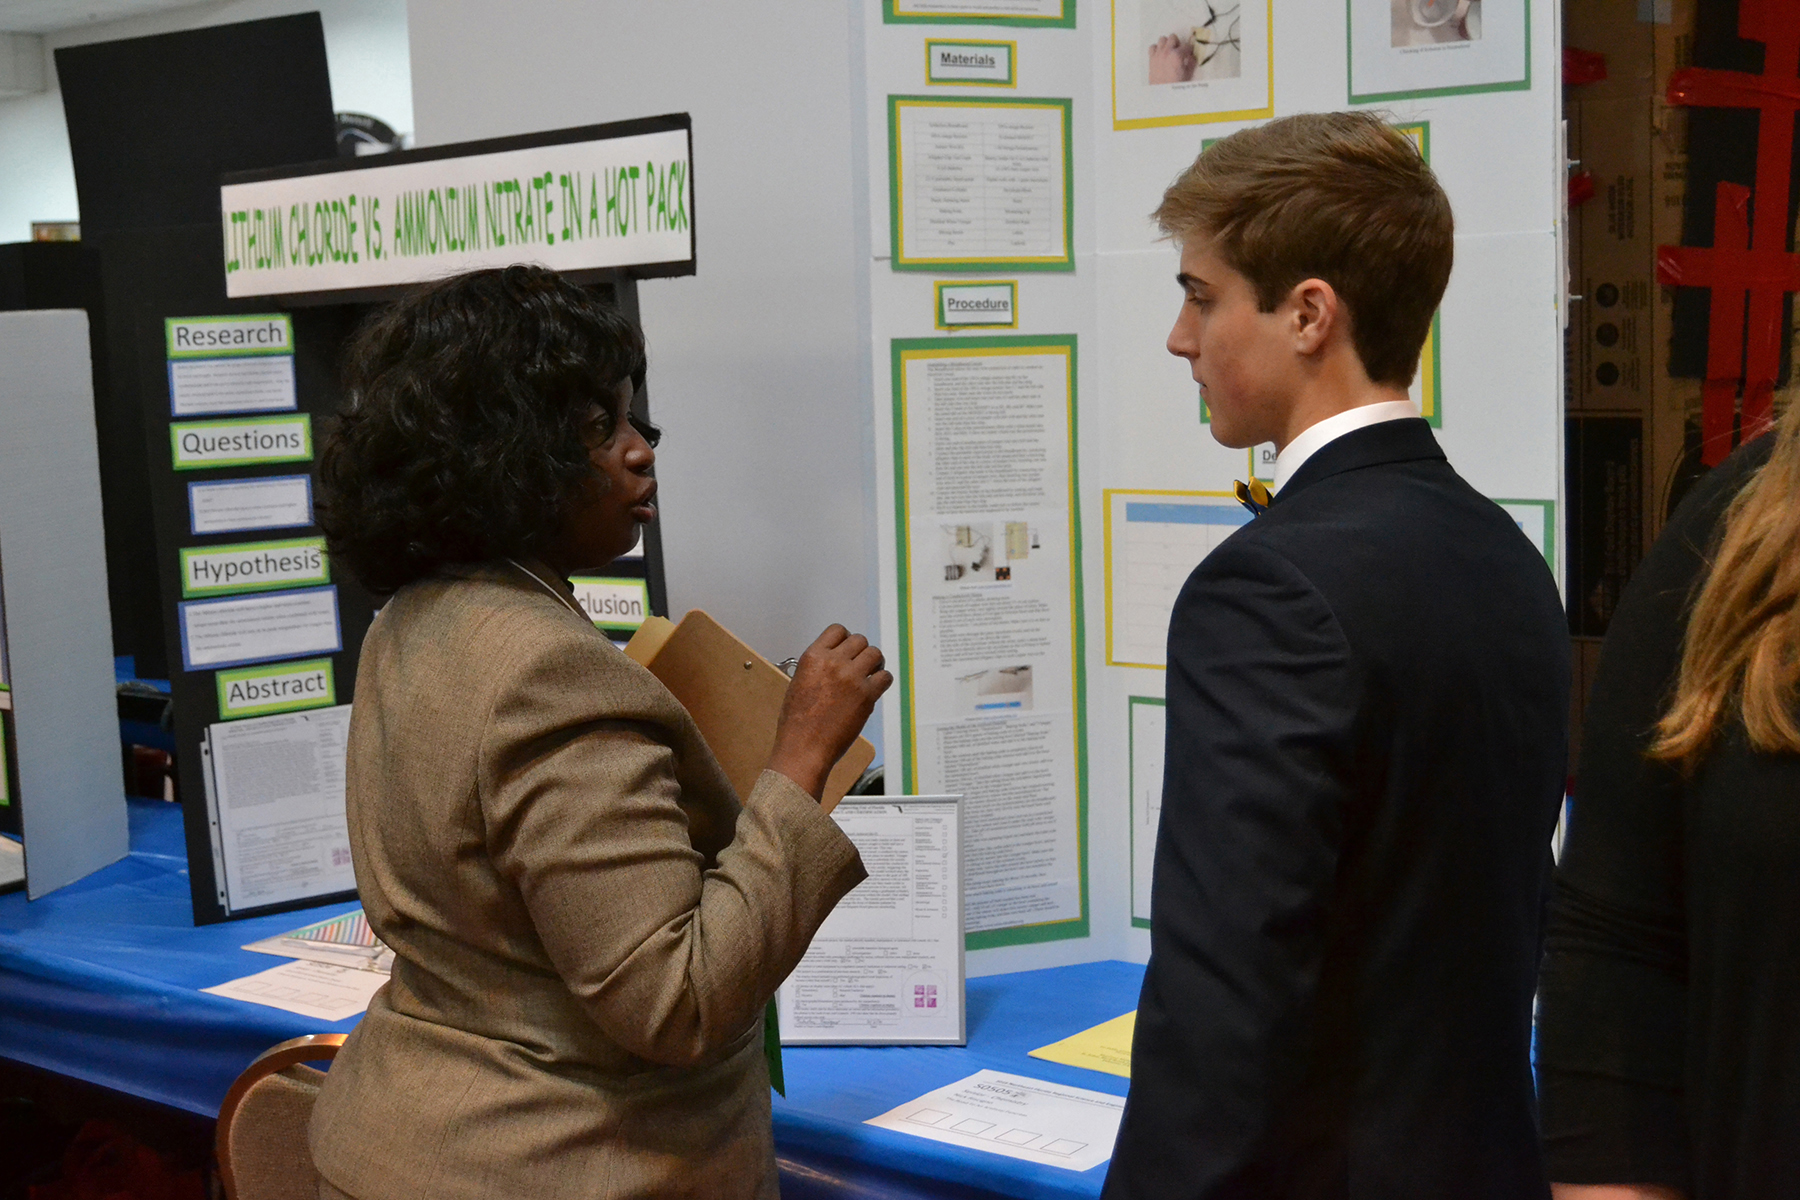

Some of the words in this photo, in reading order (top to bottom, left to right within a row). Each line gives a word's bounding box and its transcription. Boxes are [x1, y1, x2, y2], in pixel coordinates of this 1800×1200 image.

[941, 52, 995, 67] Materials
[224, 206, 285, 273] LITHIUM
[289, 194, 358, 266] CHLORIDE
[362, 196, 387, 261] VS.
[394, 184, 481, 257] AMMONIUM
[484, 171, 554, 249] NITRATE
[560, 170, 582, 242] IN
[589, 172, 600, 238] A
[605, 166, 639, 237] HOT
[647, 160, 688, 233] PACK
[947, 298, 1009, 310] Procedure
[176, 322, 283, 347] Research
[182, 429, 300, 455] Questions
[193, 550, 321, 583] Hypothesis
[579, 592, 641, 615] clusion
[229, 672, 326, 703] Abstract
